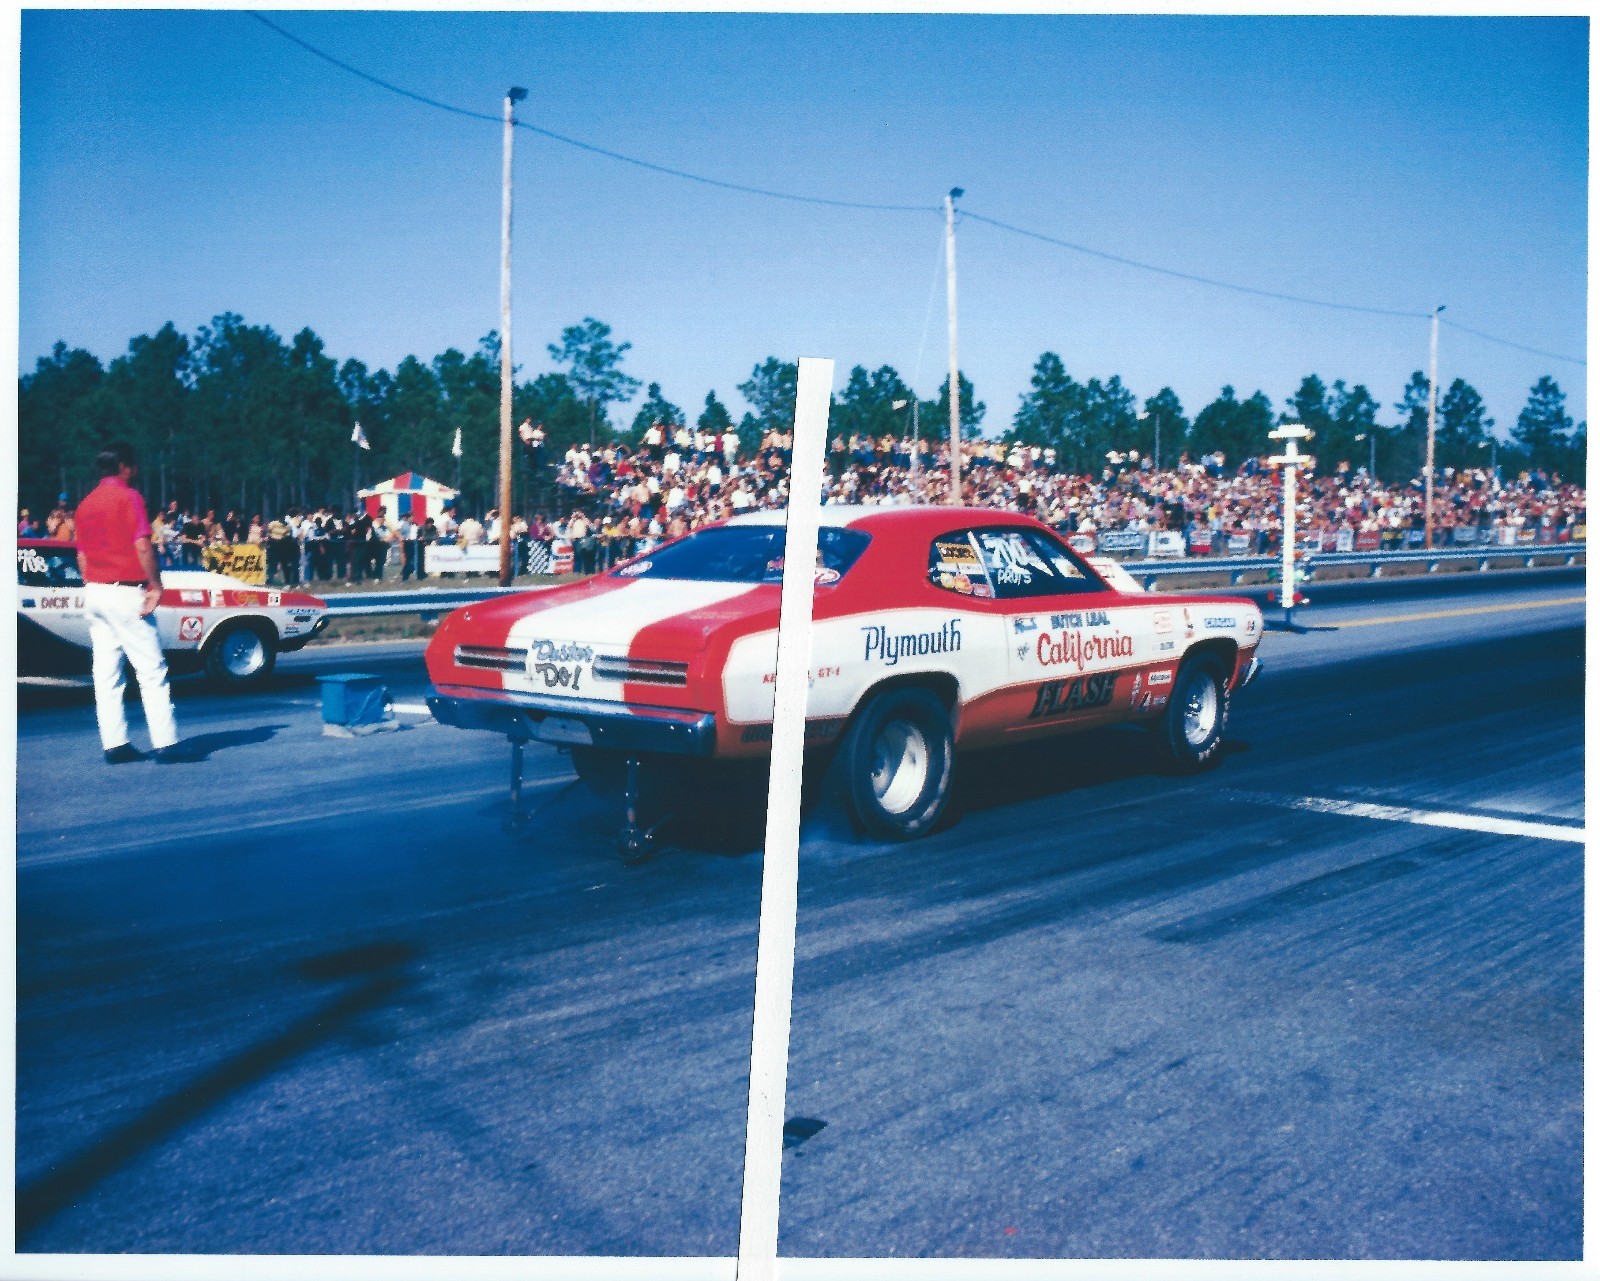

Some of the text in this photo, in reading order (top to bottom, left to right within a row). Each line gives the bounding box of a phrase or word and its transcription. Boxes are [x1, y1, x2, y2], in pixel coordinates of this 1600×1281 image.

[41, 597, 70, 609] DICK
[861, 618, 961, 666] Plymouth
[1037, 629, 1134, 671] California
[1028, 671, 1120, 719] FLASH
